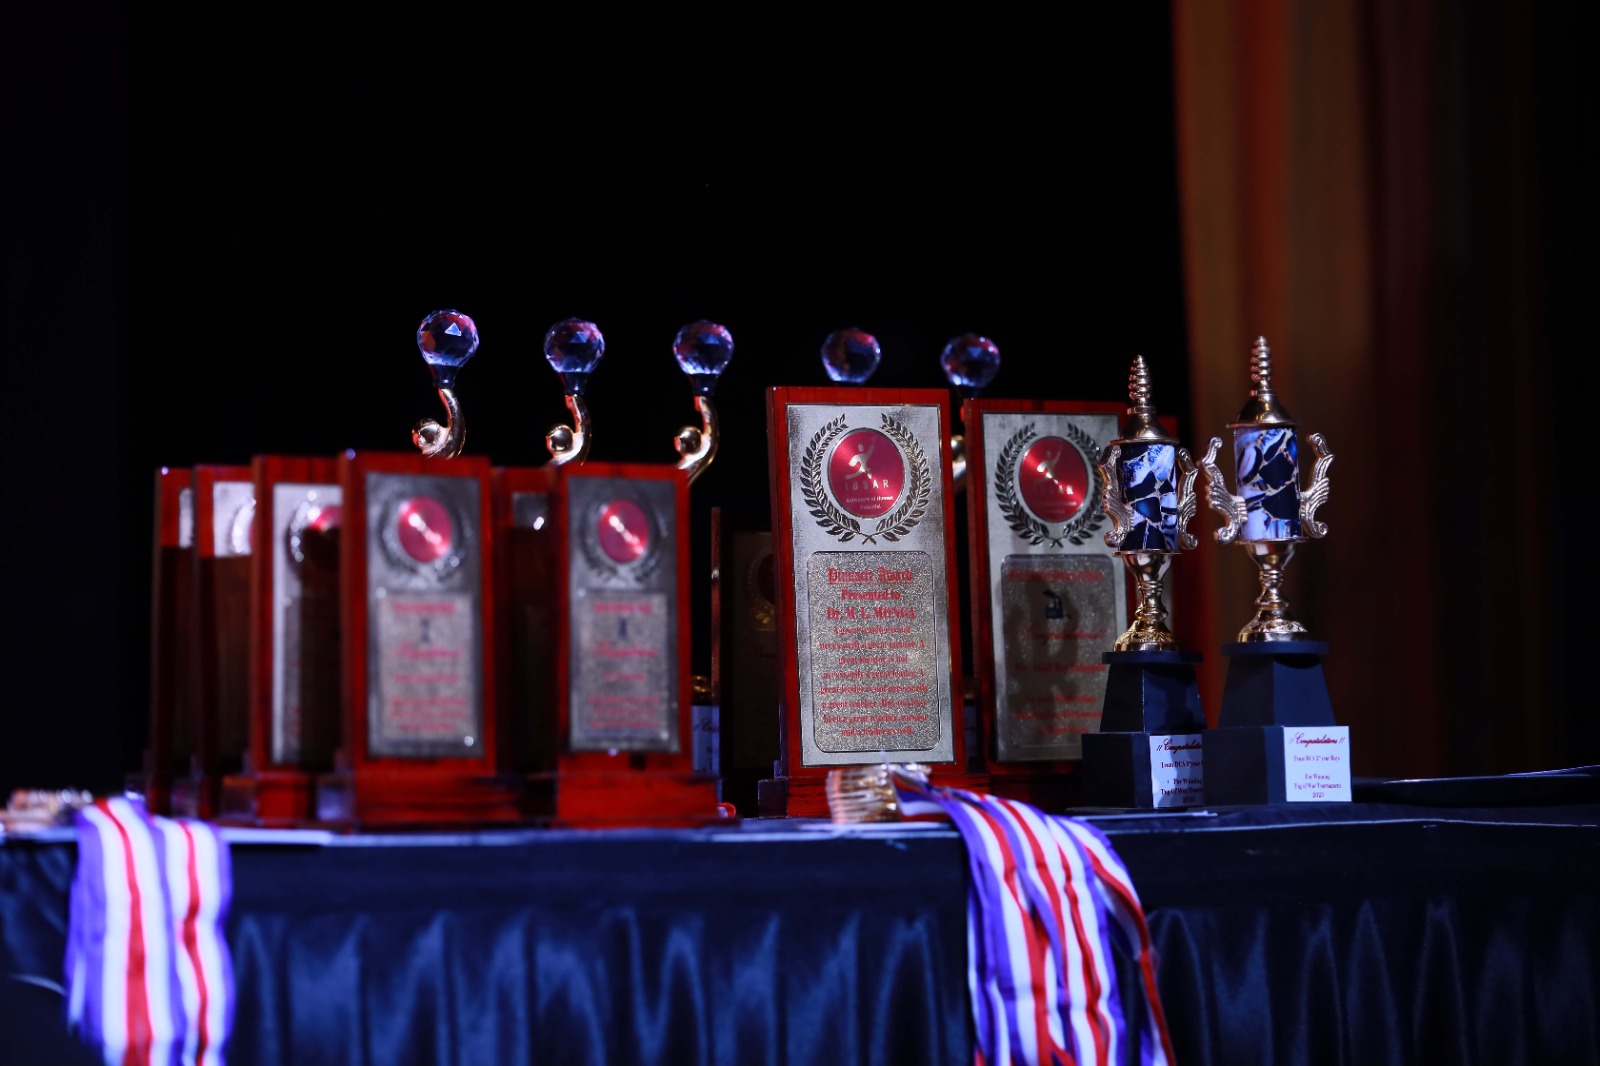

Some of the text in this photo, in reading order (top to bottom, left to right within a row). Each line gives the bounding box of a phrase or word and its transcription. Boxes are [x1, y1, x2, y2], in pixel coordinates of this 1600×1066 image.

[845, 479, 889, 490] IBSAR
[841, 588, 901, 601] Presented to
[827, 606, 842, 620] Dr.
[860, 606, 871, 619] L.
[874, 606, 916, 619] MONGA
[840, 626, 859, 636] great
[868, 641, 887, 650] great
[838, 656, 857, 667] great
[872, 670, 890, 680] great
[820, 685, 839, 695] great
[828, 701, 847, 711] great
[881, 698, 895, 707] But
[1295, 732, 1338, 747] Congratulations
[1175, 760, 1186, 768] BCA
